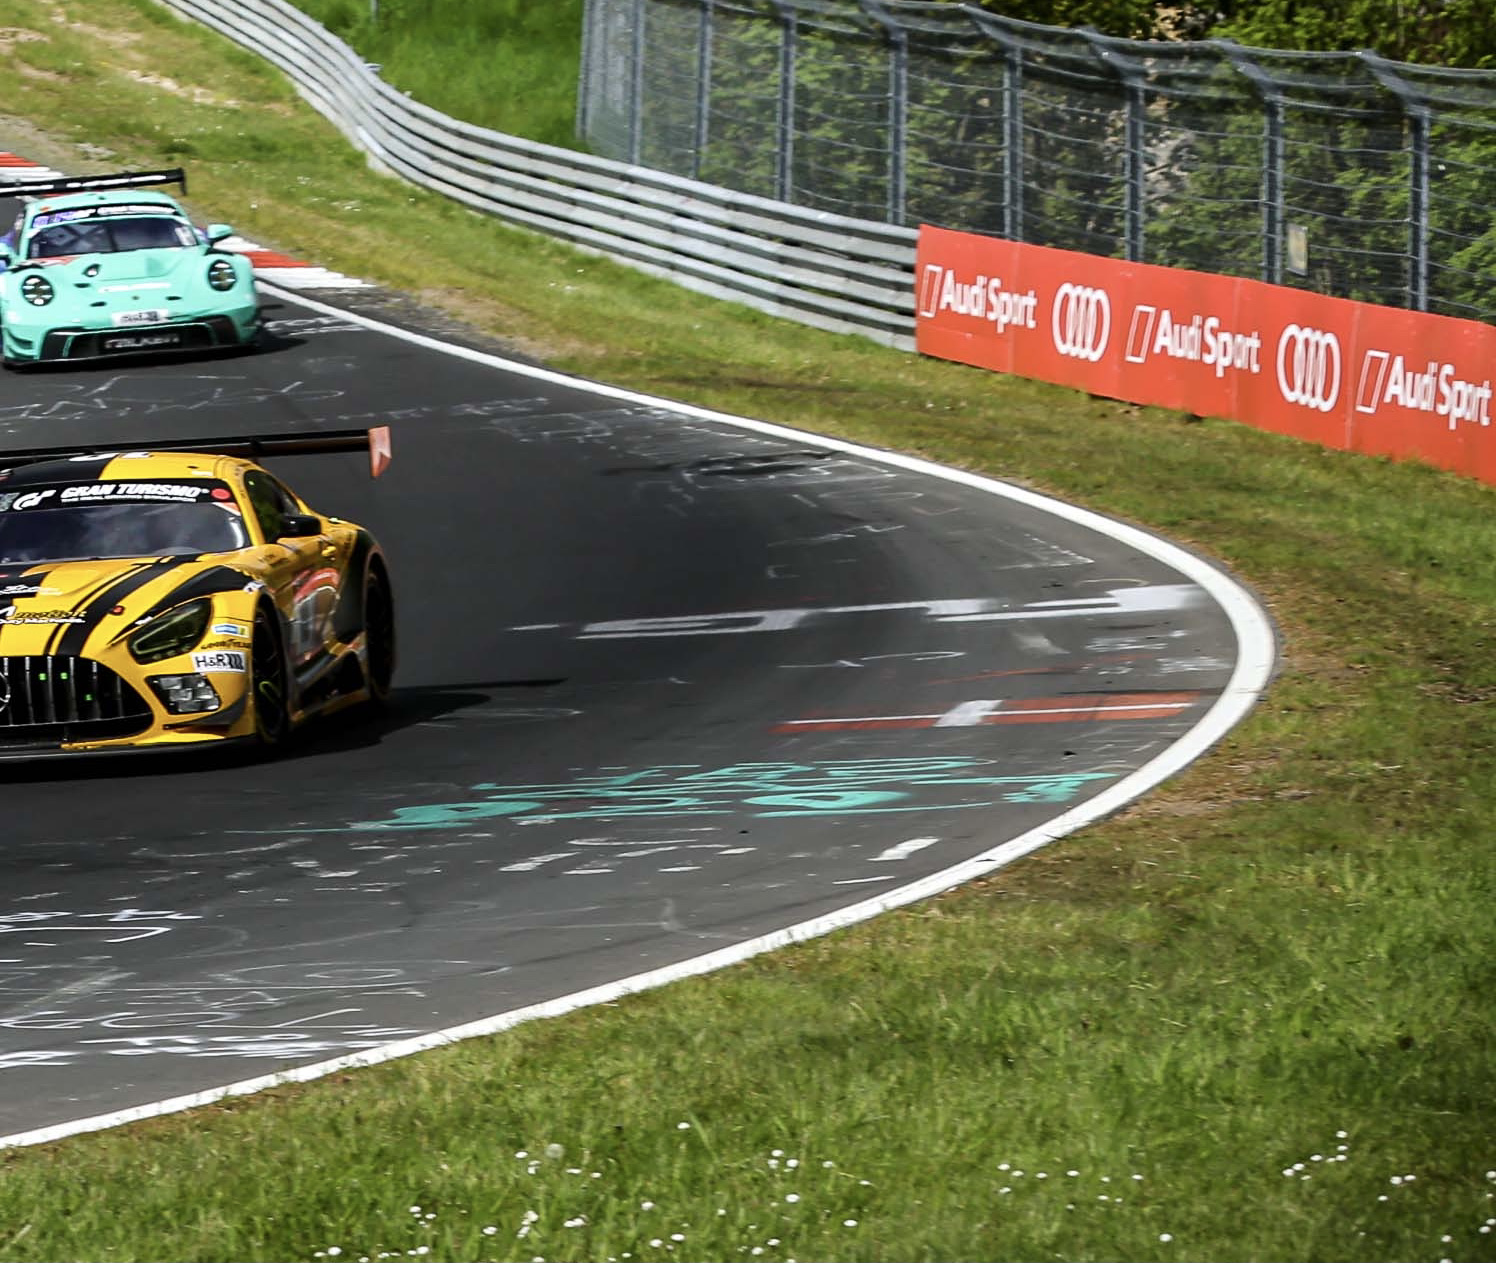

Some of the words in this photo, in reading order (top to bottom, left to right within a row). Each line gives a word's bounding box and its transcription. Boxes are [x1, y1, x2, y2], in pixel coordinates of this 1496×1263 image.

[940, 269, 985, 318] Audi
[986, 275, 1037, 332] Sport
[1154, 310, 1201, 359] Audi
[1203, 317, 1261, 378] Sport
[1383, 356, 1435, 411] Audi
[1435, 363, 1492, 430] Sport
[61, 484, 116, 498] GRAN
[194, 653, 227, 668] H&R
